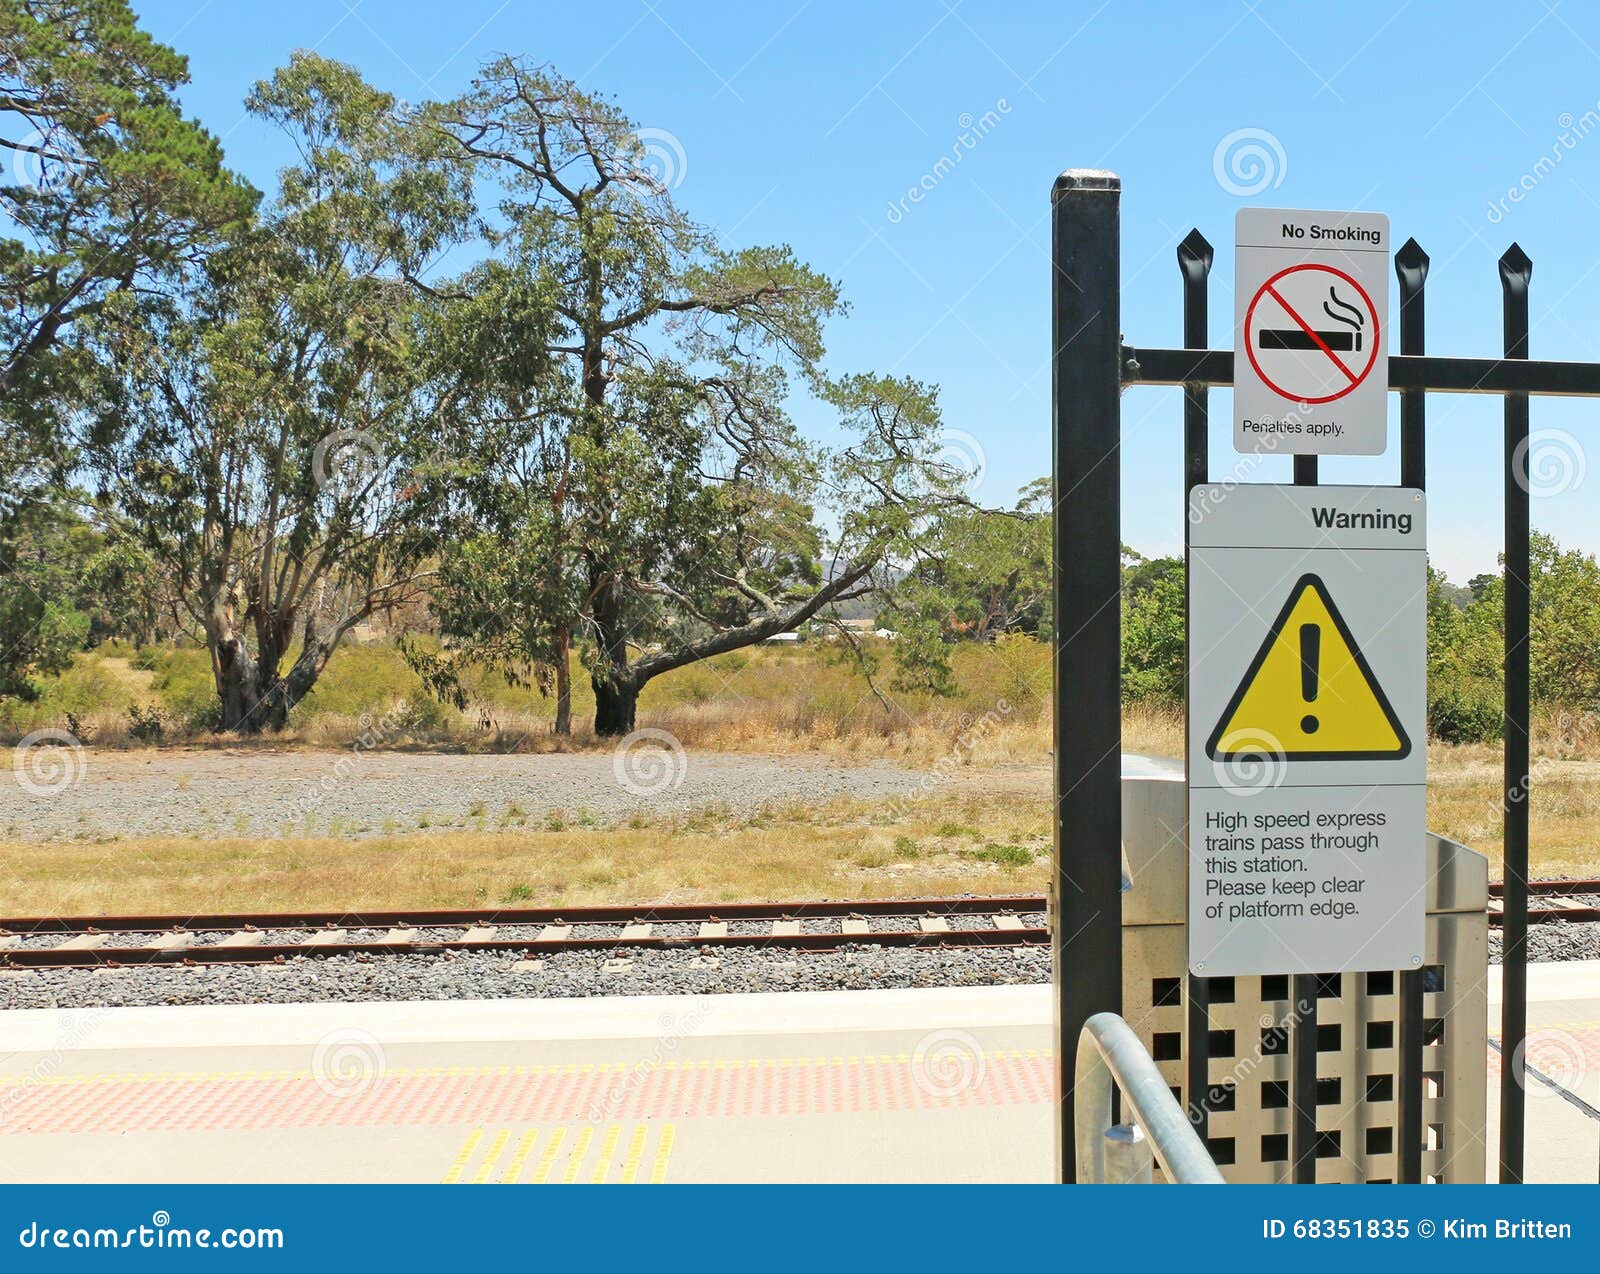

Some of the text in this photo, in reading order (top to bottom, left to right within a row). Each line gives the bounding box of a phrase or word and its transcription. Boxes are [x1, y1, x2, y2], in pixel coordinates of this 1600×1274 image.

[1282, 224, 1381, 244] No Smoking
[1242, 420, 1345, 437] Penalties apply.
[1312, 507, 1412, 535] Warning
[1206, 811, 1387, 832] High speed express
[1205, 832, 1379, 854] trains pass through
[1205, 856, 1308, 873] this station.
[1206, 877, 1366, 898] Please keep clear
[1205, 899, 1360, 922] of platform edge.
